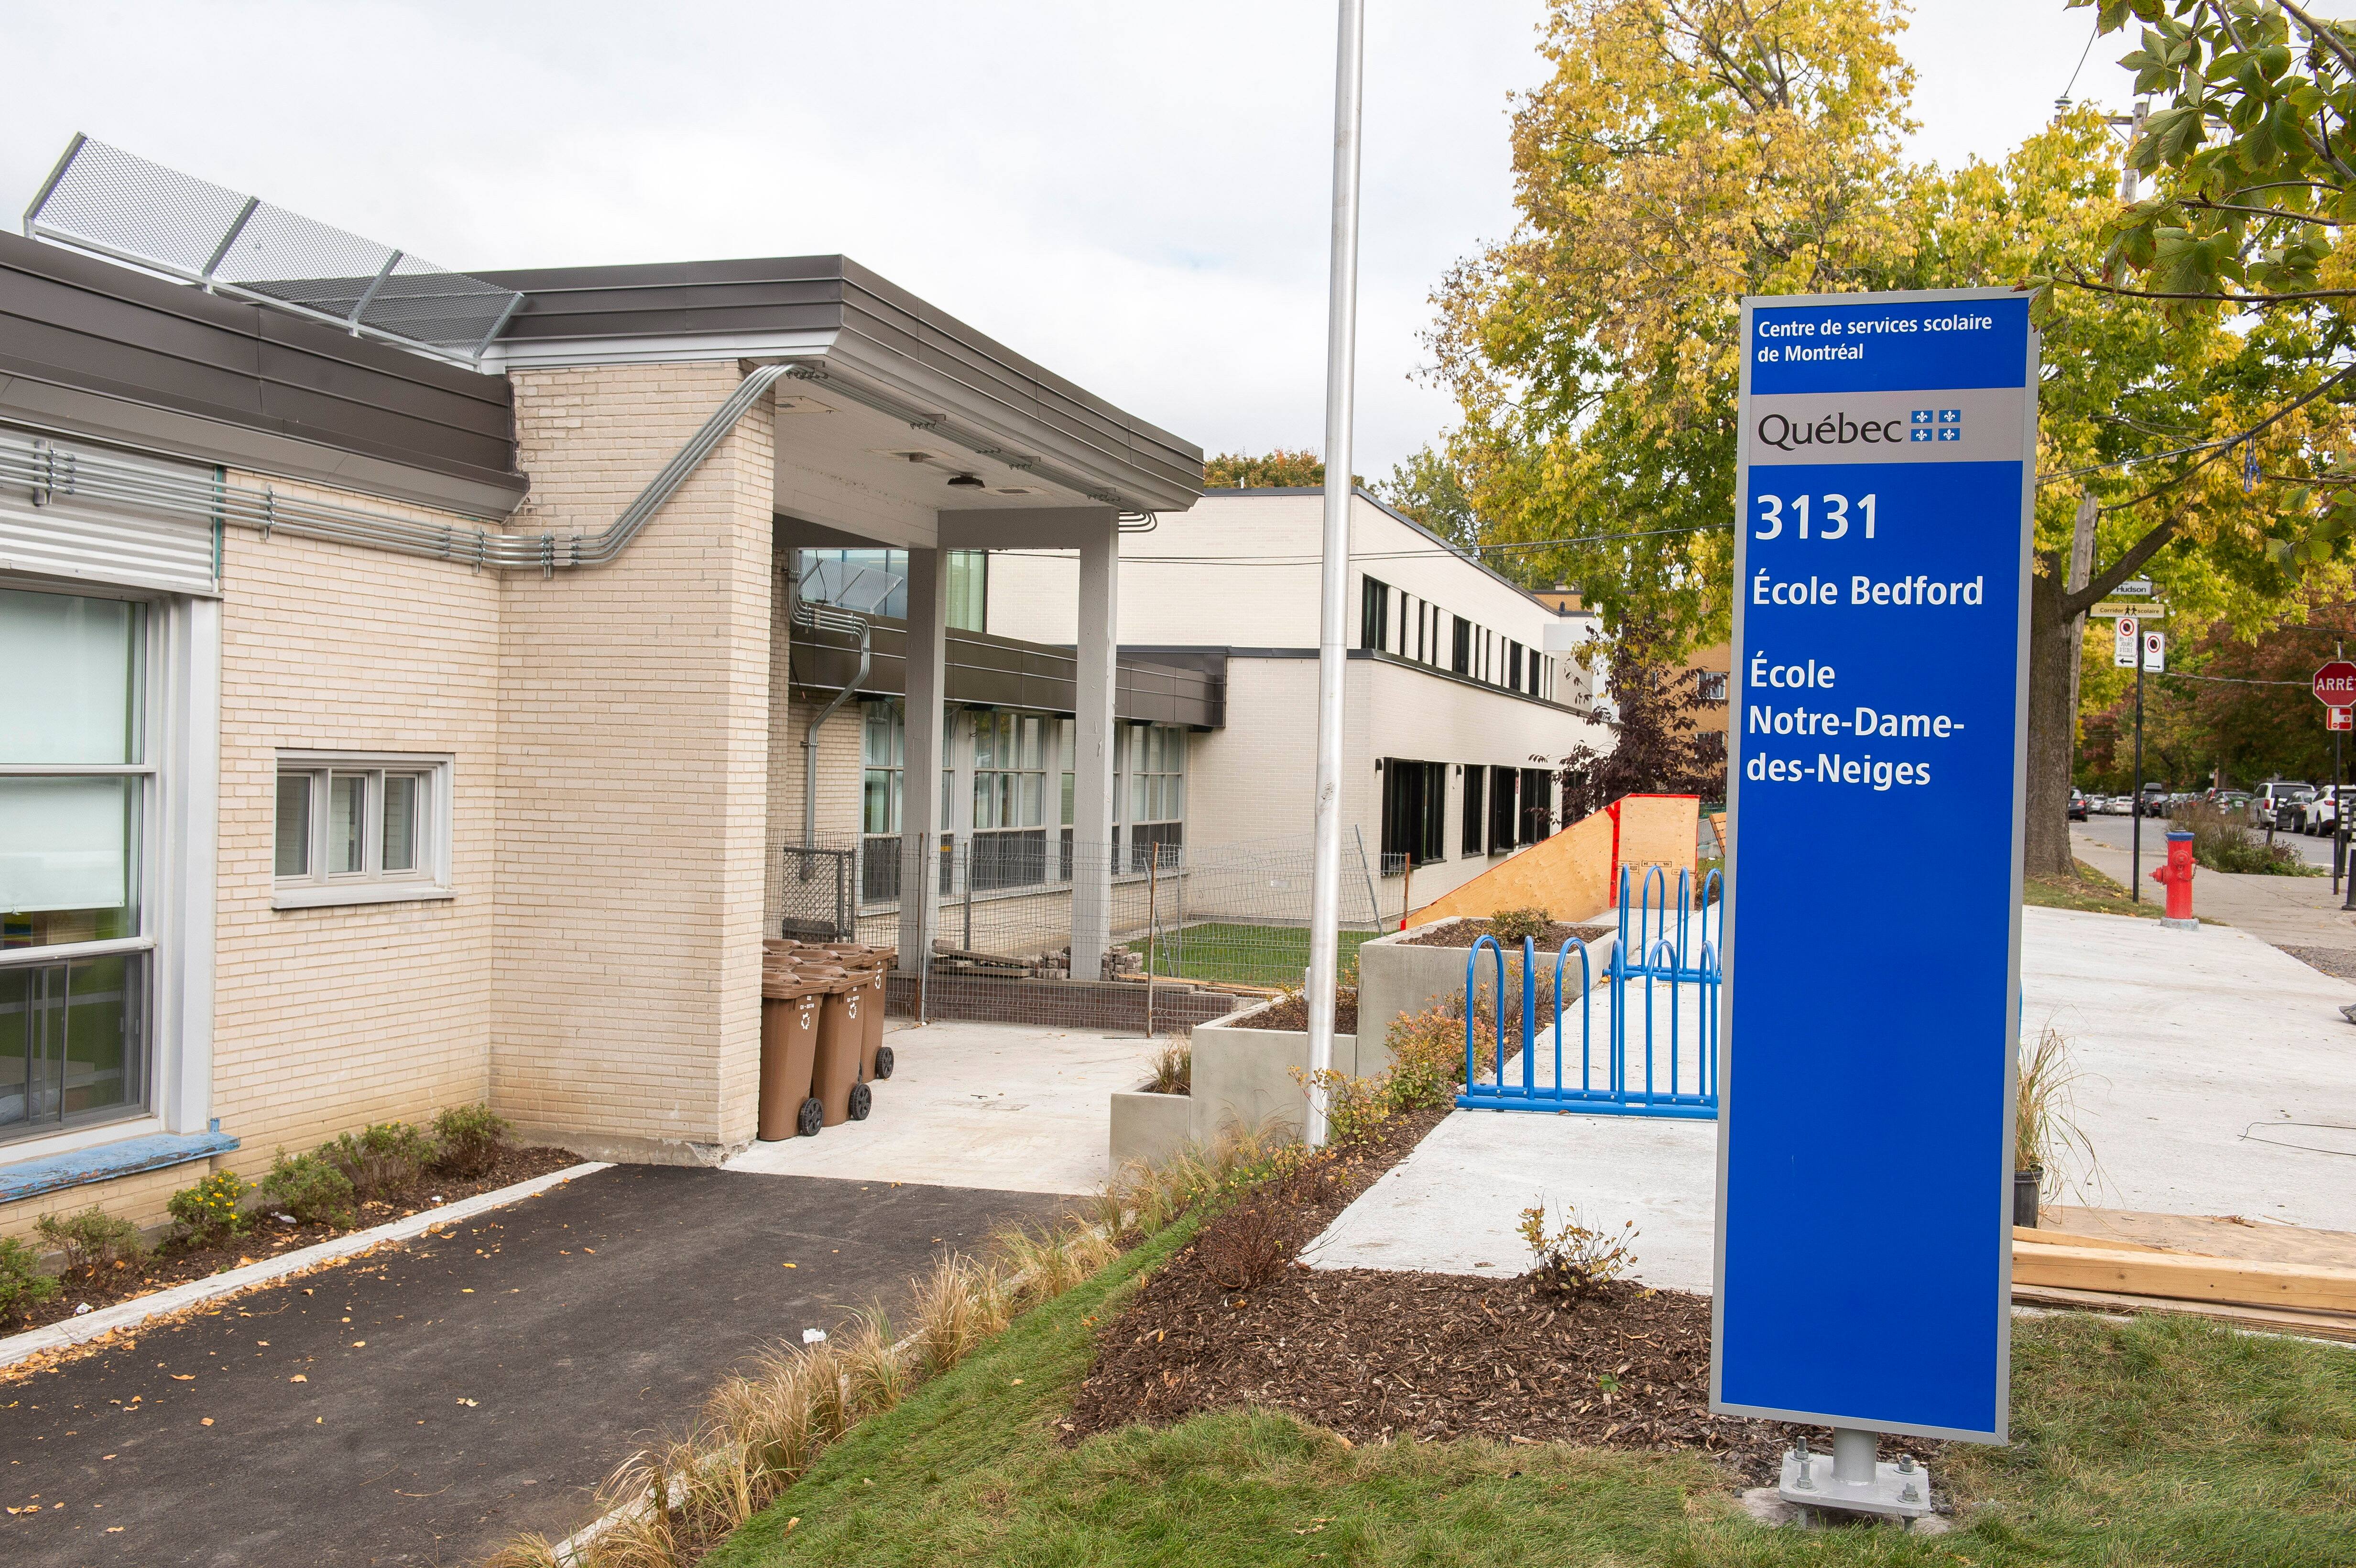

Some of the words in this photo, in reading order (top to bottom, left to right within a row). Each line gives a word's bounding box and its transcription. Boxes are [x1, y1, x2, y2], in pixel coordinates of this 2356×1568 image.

[1758, 321, 1815, 338] Centre
[1820, 319, 1842, 336] de
[1847, 317, 1918, 334] services
[1923, 314, 1992, 332] scolaire
[1758, 346, 1779, 362] de
[1785, 343, 1863, 361] Montréal
[1758, 412, 1903, 452] Québec
[1755, 493, 1876, 540] 3131
[1753, 568, 1838, 605] École
[1851, 575, 1983, 606] Bedford
[1751, 650, 1835, 688] École
[2316, 675, 2356, 691] ARRÊ
[1749, 705, 1965, 738] Notre-Dame-
[1746, 752, 1931, 792] des-Neiges
